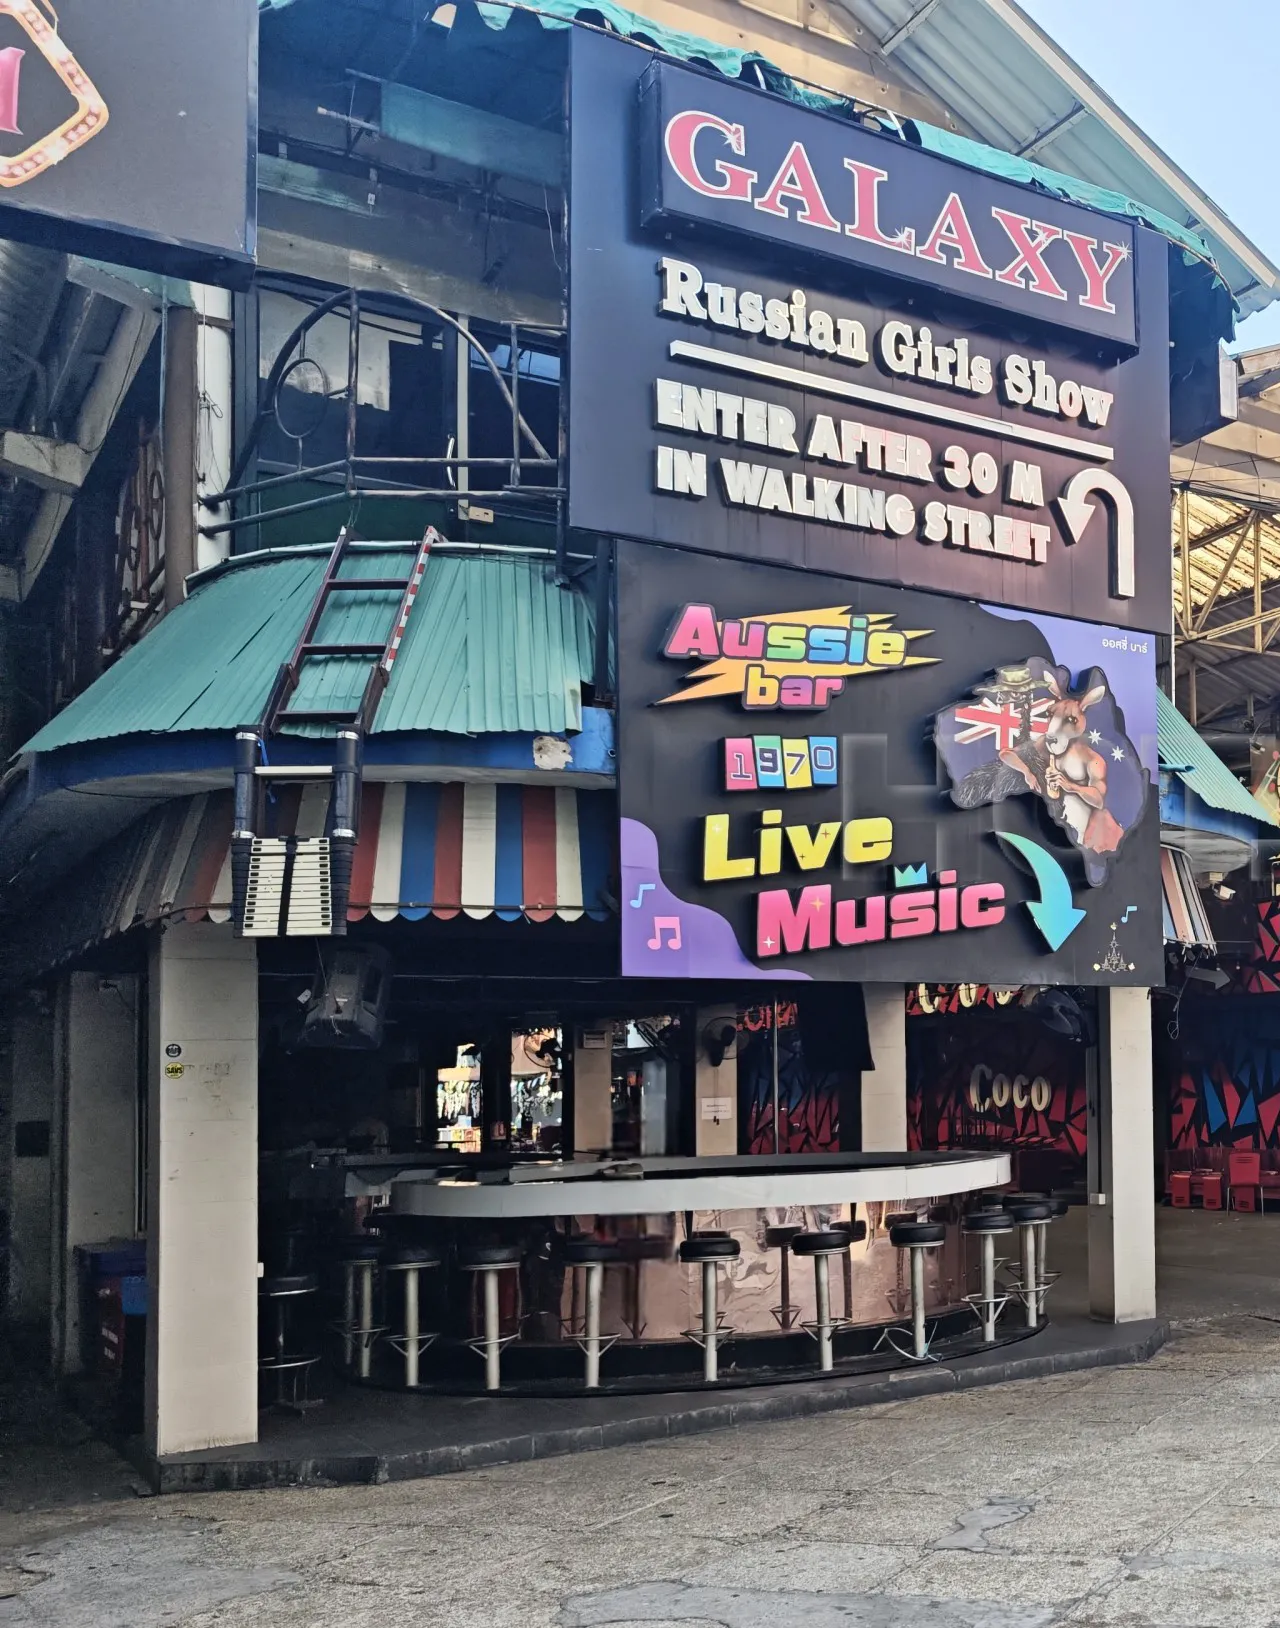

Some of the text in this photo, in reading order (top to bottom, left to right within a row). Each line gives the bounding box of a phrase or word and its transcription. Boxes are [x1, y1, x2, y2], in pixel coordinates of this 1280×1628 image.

[663, 109, 1131, 314] GALAXY
[656, 257, 1114, 429] Russian Girls Show
[654, 377, 1044, 507] ENTER AFTER 30 M
[654, 446, 1051, 563] IN WALKING STREET
[665, 603, 908, 667] Aussie
[743, 664, 845, 710] bar
[728, 743, 838, 781] 1970
[702, 809, 894, 883] Live
[756, 869, 1006, 958] Music
